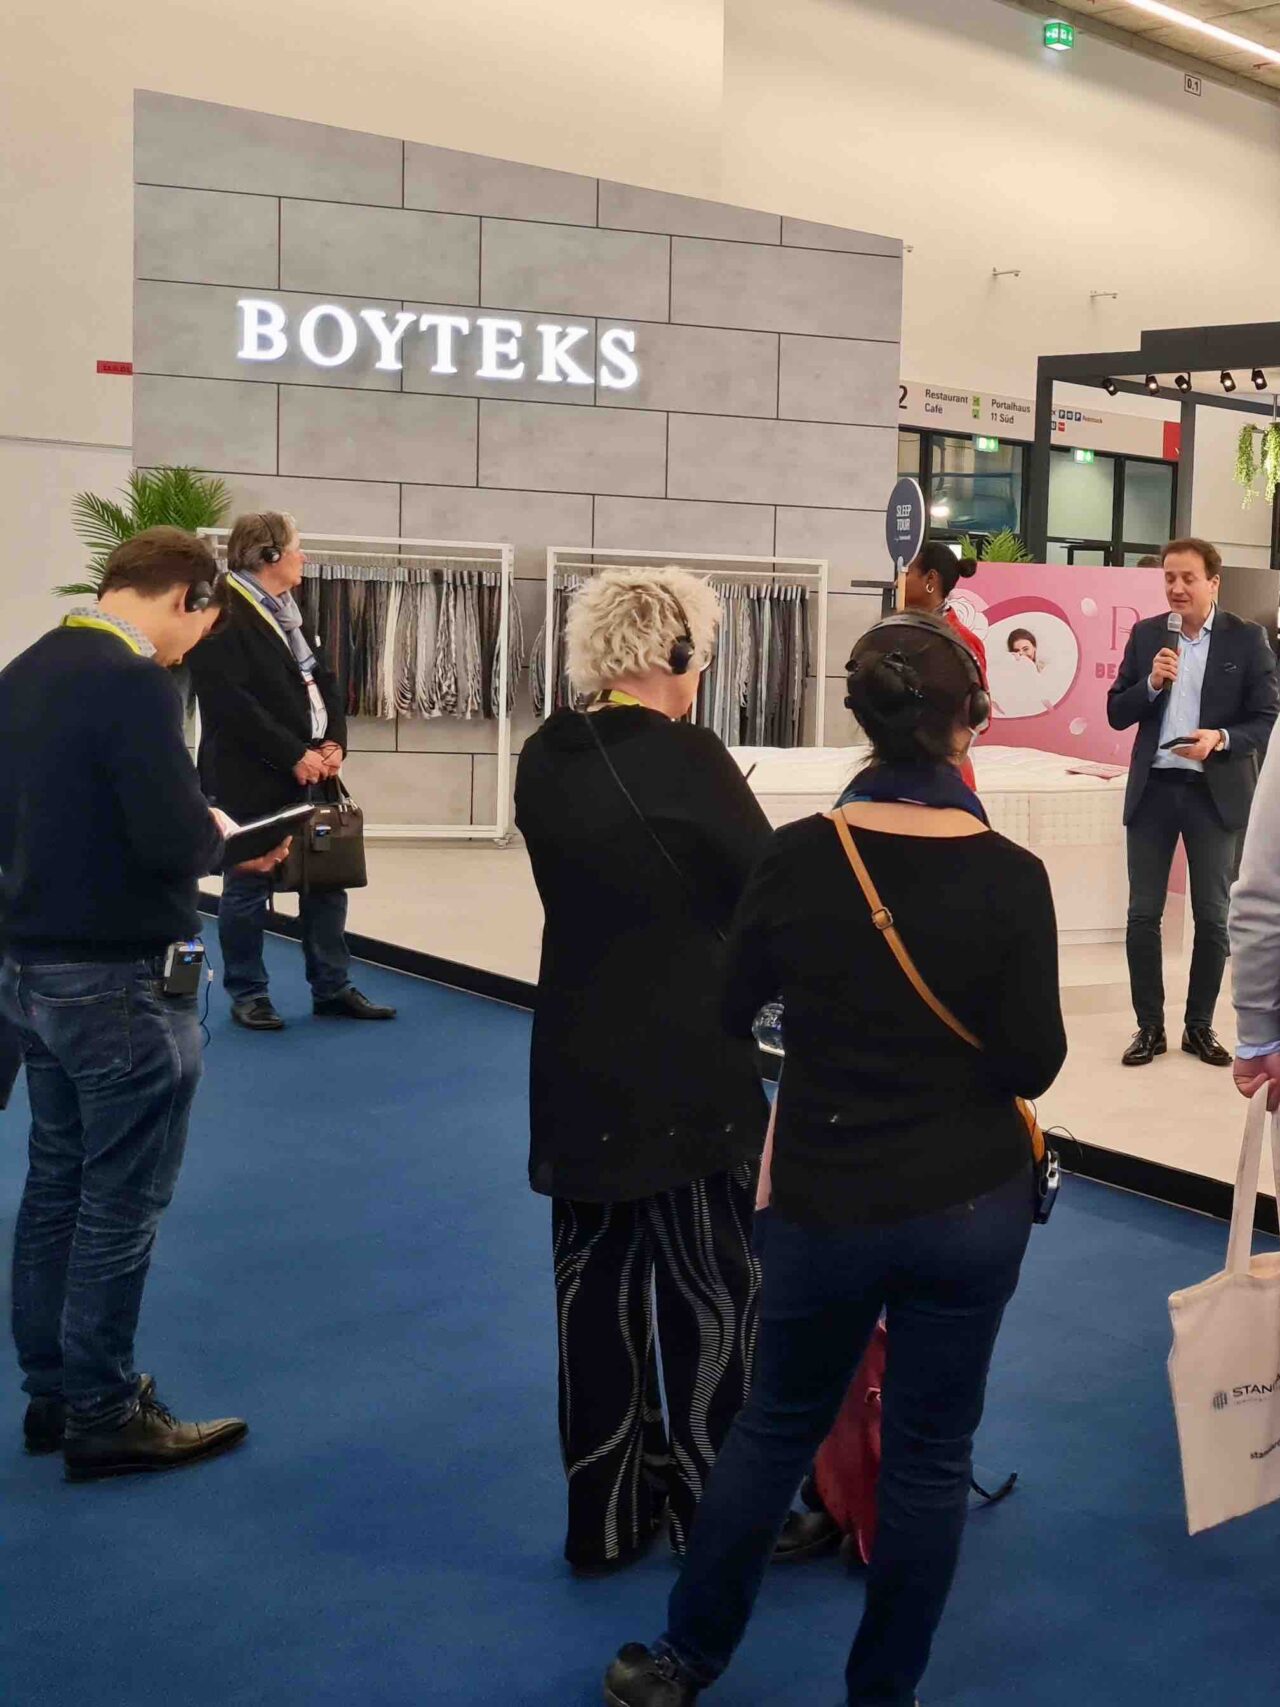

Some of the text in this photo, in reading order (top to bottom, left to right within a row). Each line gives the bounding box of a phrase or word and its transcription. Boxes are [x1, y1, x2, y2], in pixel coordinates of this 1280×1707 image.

[1187, 78, 1199, 92] 0.1
[236, 299, 639, 390] BOYTEKS
[925, 388, 968, 404] Restaurant
[925, 402, 943, 414] Café
[991, 398, 1031, 413] Portalhaus
[991, 412, 1014, 424] 11 Süd
[896, 505, 912, 517] SLEEP
[896, 518, 911, 531] TOUR
